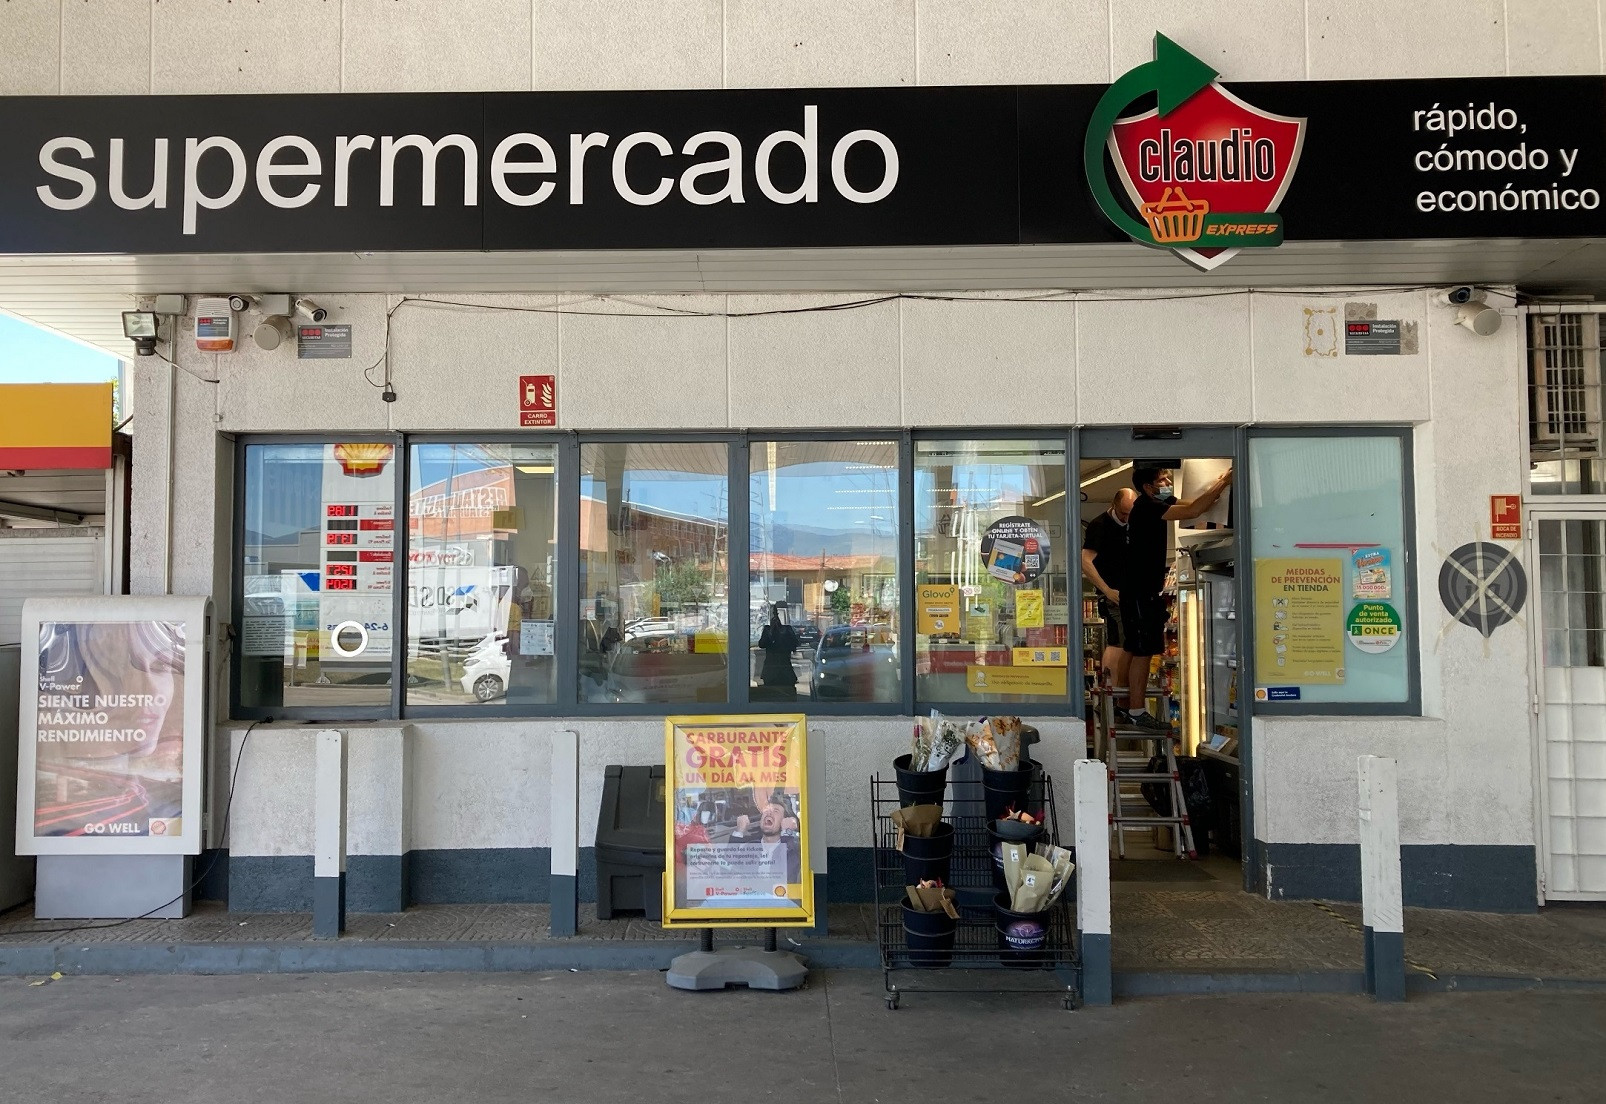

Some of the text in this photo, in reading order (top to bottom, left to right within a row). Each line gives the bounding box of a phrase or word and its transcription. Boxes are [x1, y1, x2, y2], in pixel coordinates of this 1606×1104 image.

[1413, 102, 1527, 137] rápido,
[1138, 127, 1275, 184] claudio
[1414, 142, 1578, 178] cómodo y
[36, 104, 900, 236] supermercado
[1416, 181, 1600, 212] económico
[1206, 221, 1280, 237] EXPRESS
[1271, 574, 1341, 584] DE PREVENCIÓN
[1286, 568, 1326, 576] MEDIDAS
[922, 590, 951, 599] Glovo
[1283, 584, 1329, 592] EN TIENDA
[1364, 627, 1395, 635] ONCE
[39, 683, 80, 691] V-Power
[38, 694, 167, 708] SIENTE NUESTRO
[38, 709, 109, 725] MÁXIMO
[37, 728, 147, 742] RENDIMIENTO
[686, 731, 787, 744] CARBURANTE
[686, 746, 787, 768] GRATIS
[686, 769, 787, 783] UN DÍA AL MES
[84, 823, 140, 834] GO WELL
